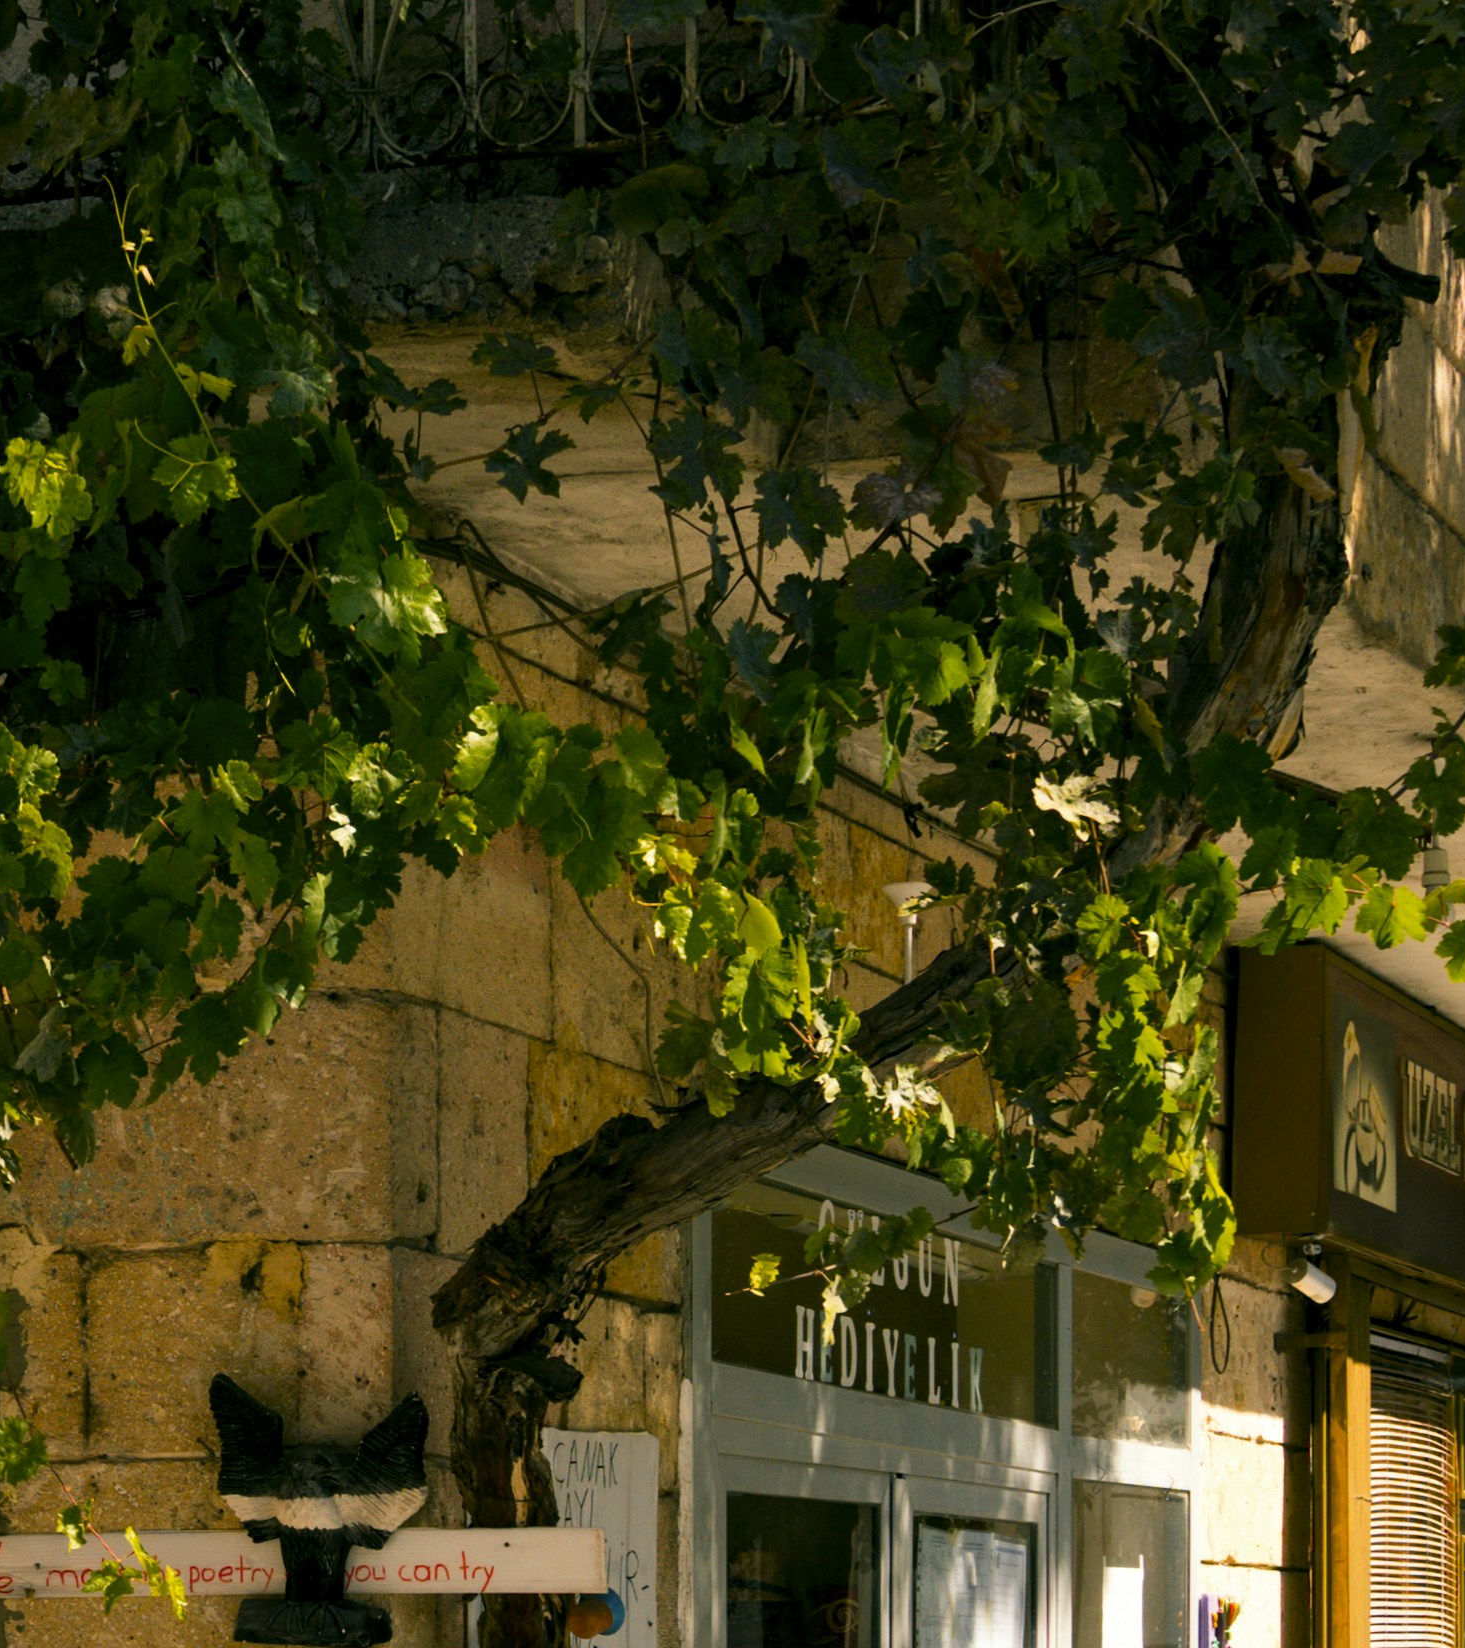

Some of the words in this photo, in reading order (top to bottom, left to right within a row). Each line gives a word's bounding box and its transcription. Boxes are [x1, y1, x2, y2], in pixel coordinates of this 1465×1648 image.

[552, 1439, 620, 1489] ÇANAK
[189, 1553, 274, 1593] poetry
[398, 1562, 449, 1583] can
[460, 1550, 496, 1592] try
